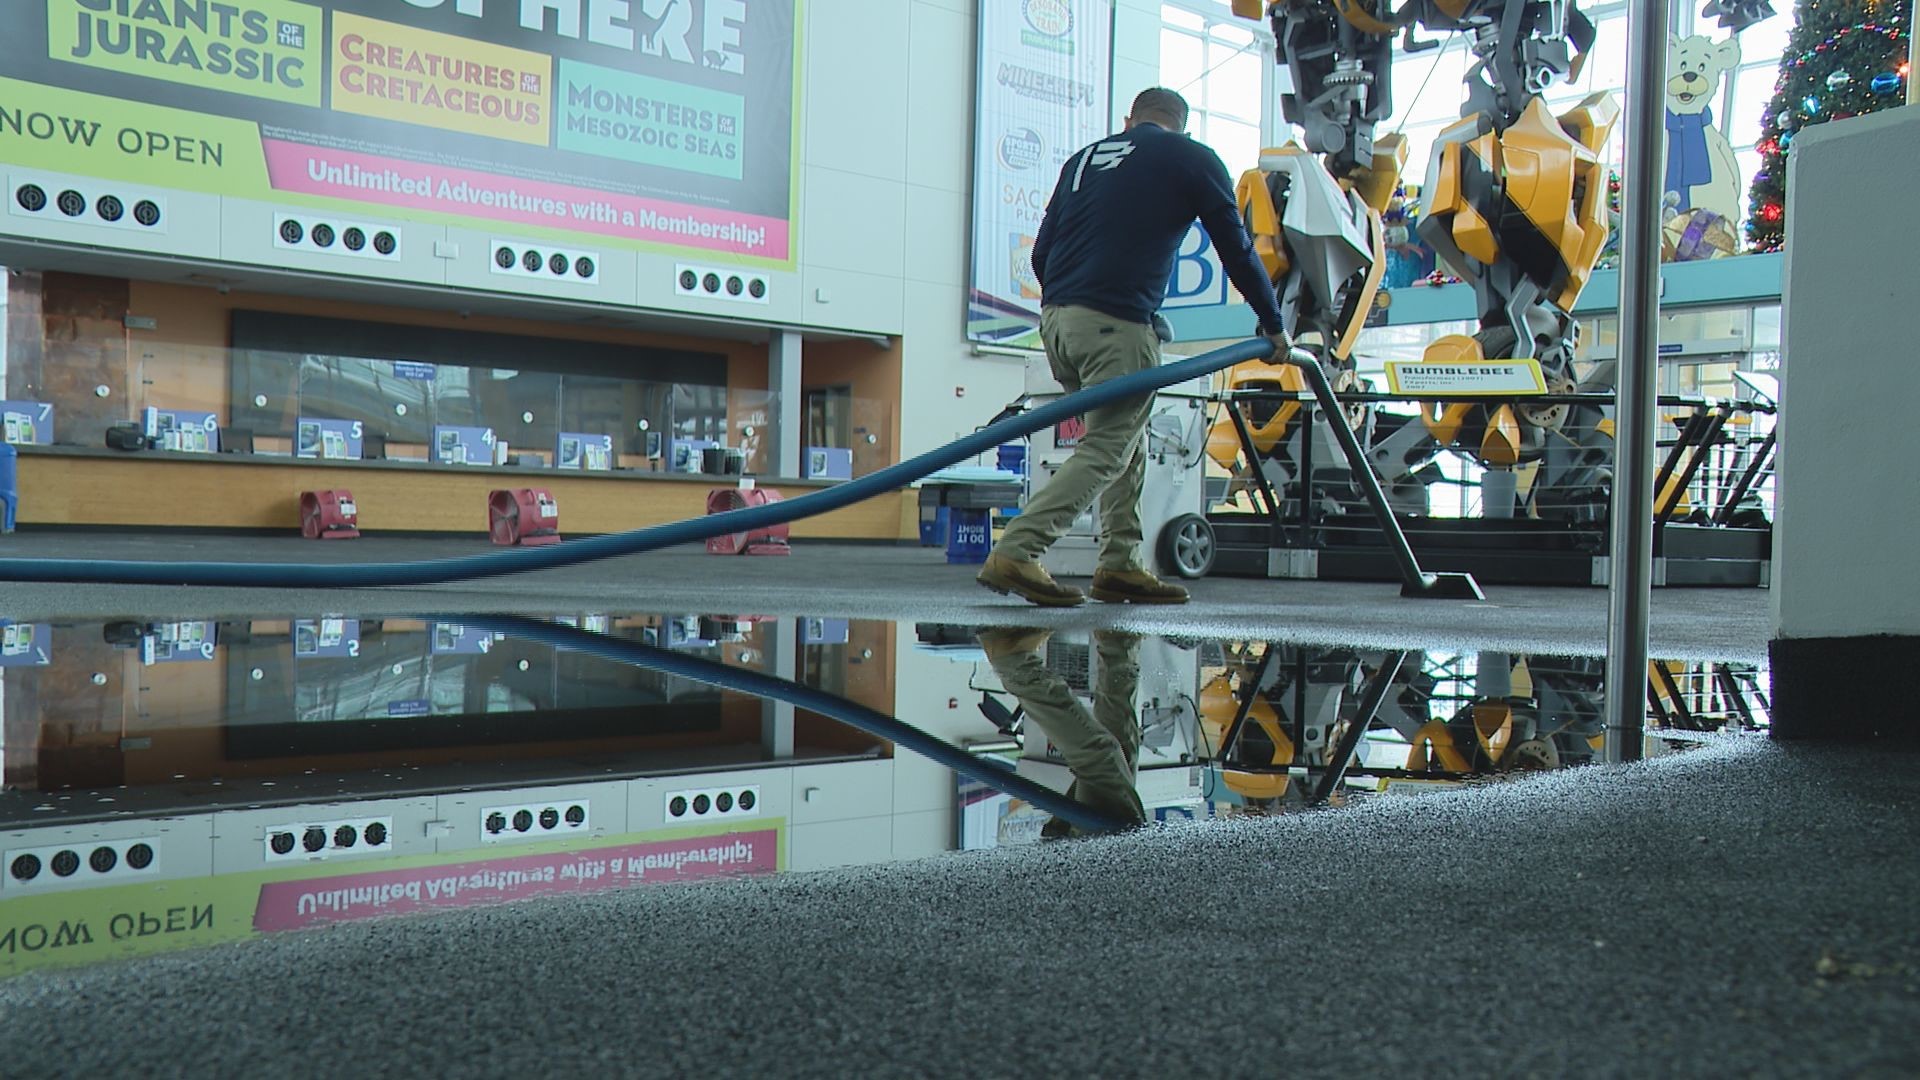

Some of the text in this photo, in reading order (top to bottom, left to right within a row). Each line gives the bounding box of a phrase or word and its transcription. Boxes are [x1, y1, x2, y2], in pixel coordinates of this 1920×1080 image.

[73, 0, 268, 45] IANTS
[281, 23, 299, 35] OF
[278, 33, 303, 47] THE
[402, 0, 747, 75] HERE
[71, 11, 305, 89] JURASSIC
[340, 33, 515, 91] CREATURES
[521, 81, 540, 94] THE
[524, 74, 536, 84] OF
[339, 64, 540, 125] CRETACEOUS
[568, 80, 713, 132] MONSTERS
[719, 124, 734, 135] THE
[721, 117, 732, 126] OF
[0, 107, 101, 147] NOW
[117, 127, 223, 167] OPEN
[567, 110, 737, 161] MESOZOIC SEAS
[307, 158, 432, 198] Unlimited
[436, 179, 567, 217] Adventures
[571, 200, 618, 225] with
[622, 211, 636, 227] a
[640, 208, 766, 248] Membership!
[1166, 220, 1214, 298] B
[1402, 367, 1514, 375] BUMBLEBEE
[38, 404, 52, 421] 7
[203, 414, 217, 431] 6
[351, 421, 363, 439] 5
[481, 428, 494, 446] 4
[602, 435, 612, 451] 3
[957, 525, 985, 533] RIGHT
[957, 533, 985, 544] DO IT
